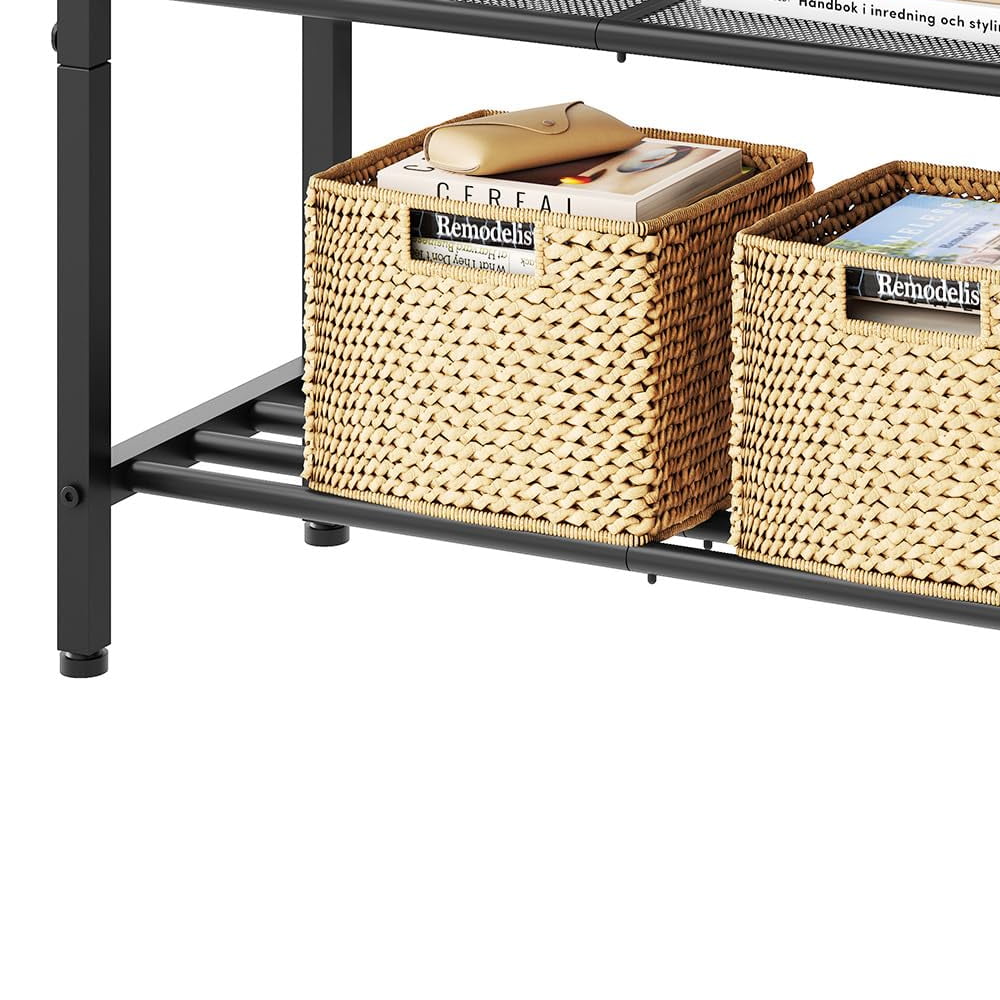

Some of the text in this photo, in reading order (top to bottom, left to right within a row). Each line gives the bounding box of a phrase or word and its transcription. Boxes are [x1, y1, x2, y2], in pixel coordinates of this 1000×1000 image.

[862, 4, 867, 15] i
[870, 5, 936, 27] inredning
[941, 13, 966, 28] och
[436, 214, 535, 246] Remodelis
[877, 273, 980, 306] Remodelis
